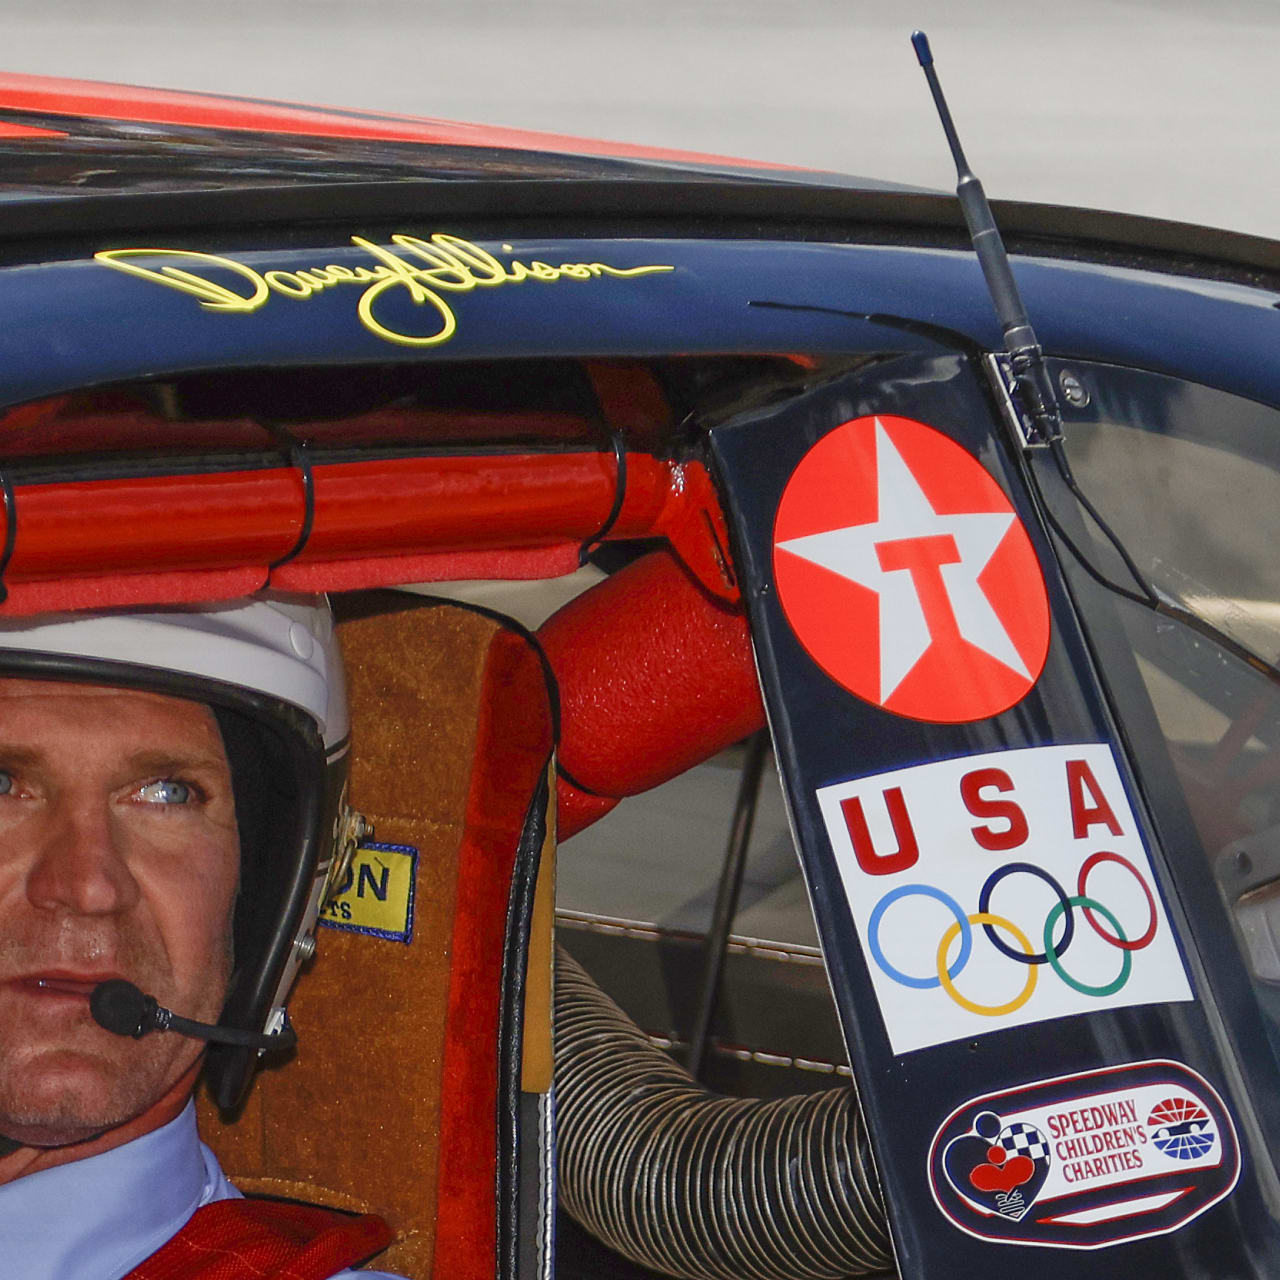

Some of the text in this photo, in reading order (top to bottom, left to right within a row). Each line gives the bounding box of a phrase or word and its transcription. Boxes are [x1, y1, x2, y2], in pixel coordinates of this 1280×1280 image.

[1047, 1099, 1139, 1139] SPEEDWAY
[1055, 1125, 1148, 1161] CHILDREN'S
[1062, 1150, 1144, 1184] CHARITIES
